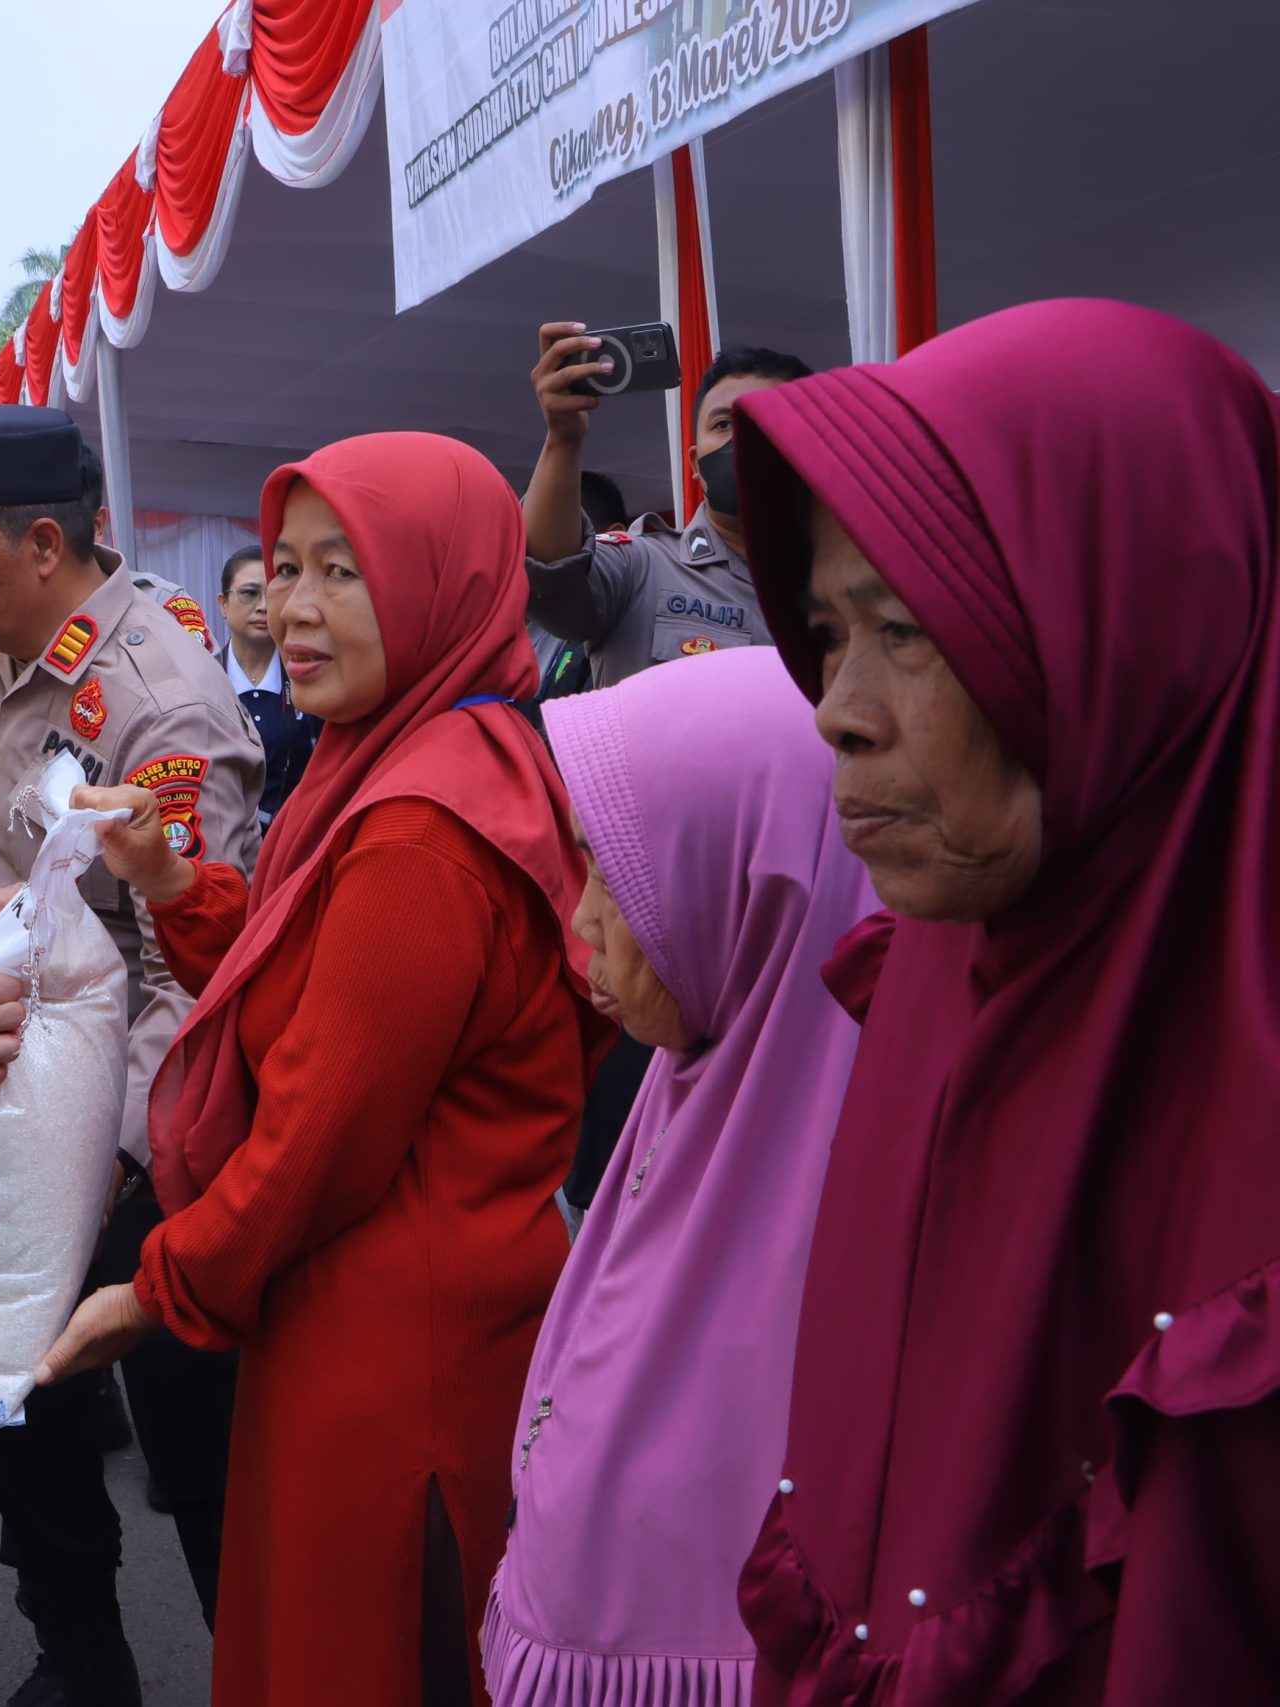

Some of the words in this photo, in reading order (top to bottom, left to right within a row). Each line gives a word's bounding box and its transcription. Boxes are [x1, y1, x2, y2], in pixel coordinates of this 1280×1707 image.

[489, 0, 540, 79] BULAN
[404, 124, 458, 209] YAYASAN
[455, 78, 514, 173] BUDDHA
[510, 51, 541, 127] TZU
[540, 24, 577, 104] CHI
[549, 92, 644, 191] Cikang,
[648, 65, 672, 126] 13
[677, 5, 763, 112] Maret
[666, 594, 745, 628] GALIH
[42, 730, 104, 787] PORI
[130, 763, 164, 785] POLRES
[167, 759, 201, 770] METRO
[173, 793, 192, 801] JAYA
